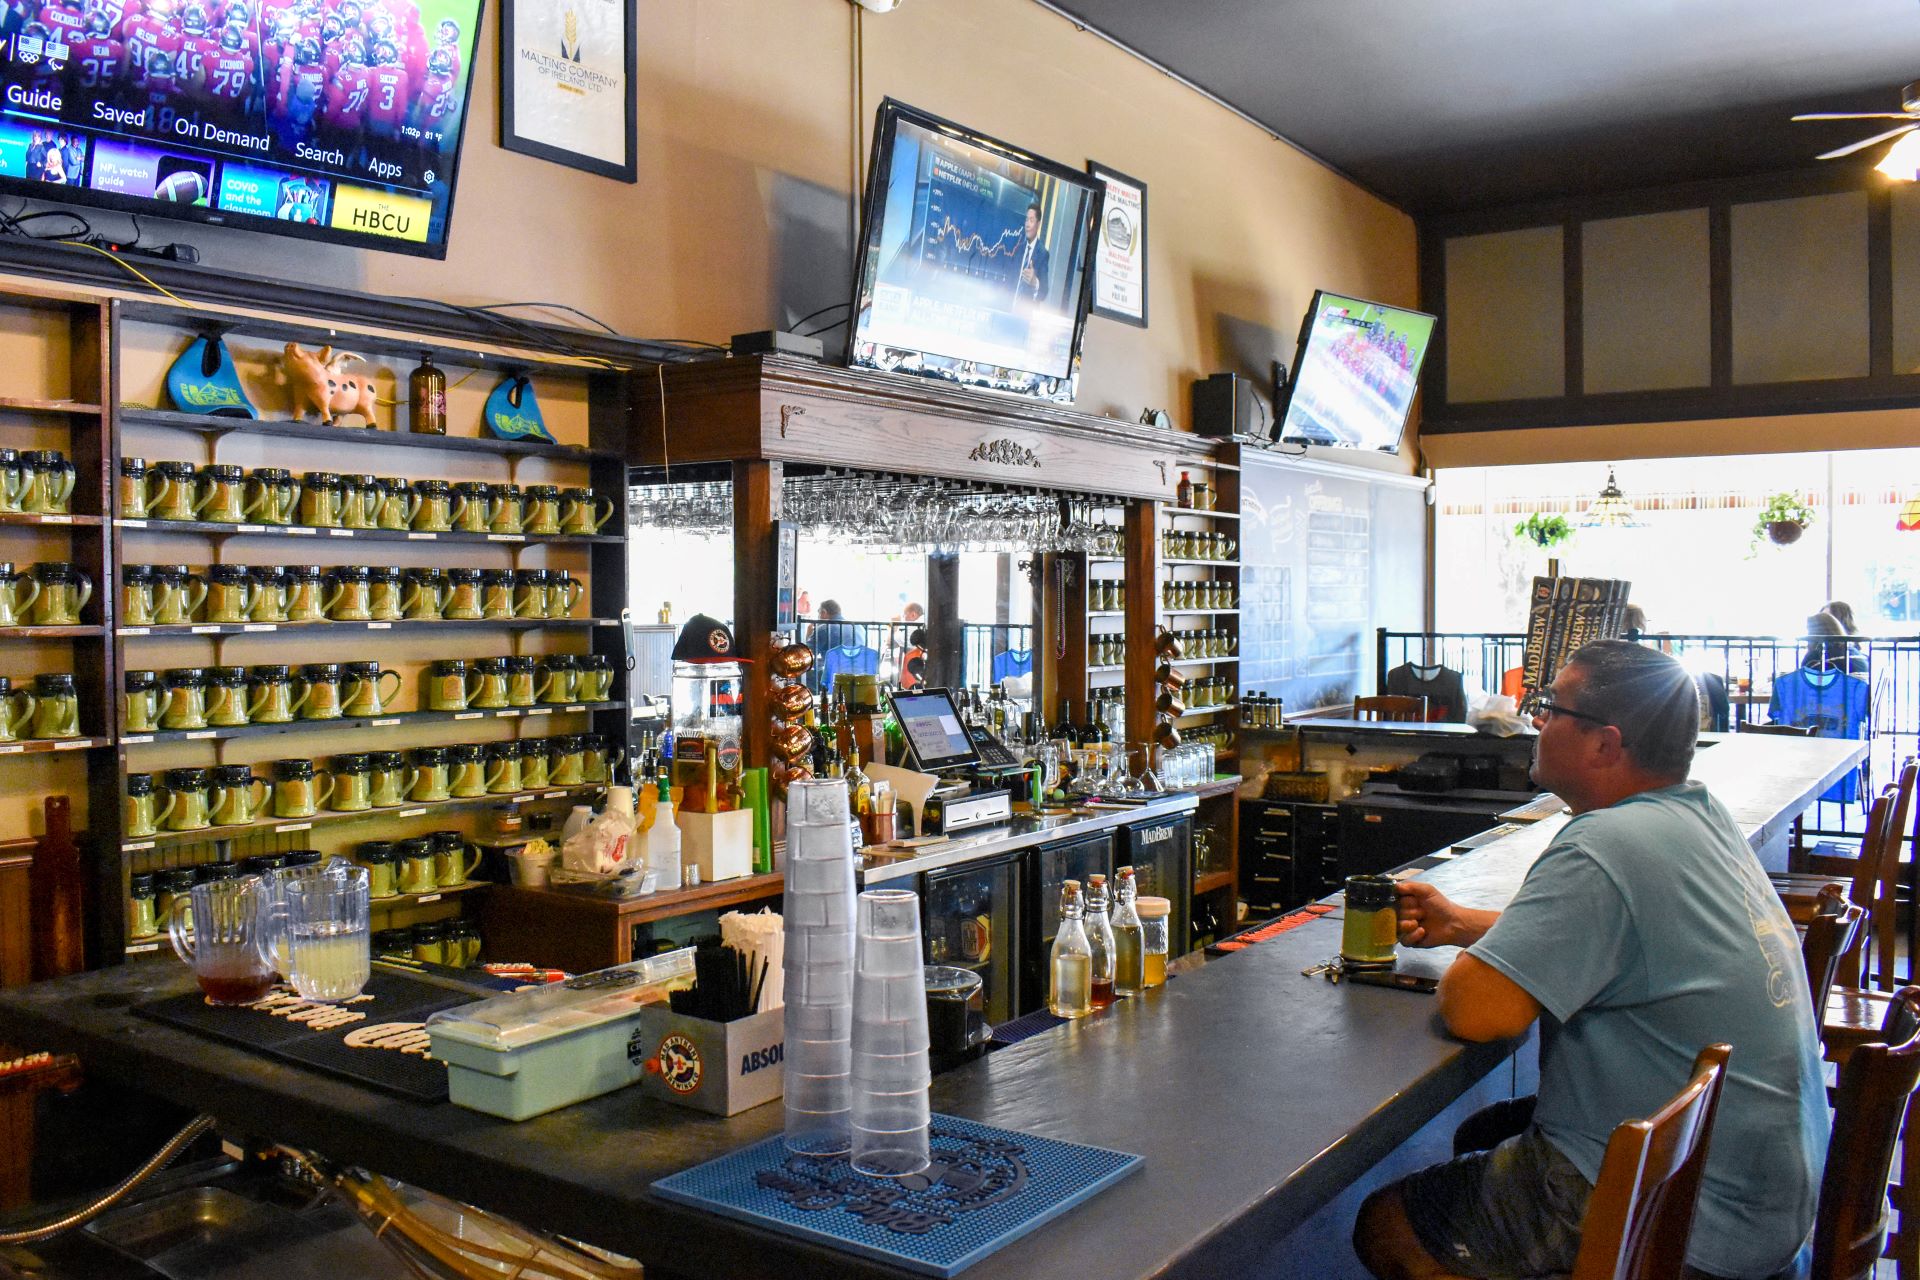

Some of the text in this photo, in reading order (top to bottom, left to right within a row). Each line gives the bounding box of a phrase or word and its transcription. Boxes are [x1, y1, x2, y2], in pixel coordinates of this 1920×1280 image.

[521, 49, 618, 88] MALTING COMPANY
[538, 67, 550, 75] OF
[212, 70, 246, 98] 79
[7, 85, 62, 111] Guide
[380, 86, 395, 110] 3
[93, 102, 146, 127] Saved
[175, 118, 270, 151] On Demand
[401, 125, 421, 139] 1:02p
[295, 142, 344, 166] Search
[99, 163, 149, 179] NFL watch
[368, 157, 402, 179] Apps
[939, 160, 958, 173] APPLE
[98, 175, 125, 187] guide
[227, 179, 259, 193] COVID
[938, 170, 962, 186] NETFLIX
[225, 192, 262, 206] and the
[224, 204, 271, 217] classroom
[353, 208, 411, 234] HBCU
